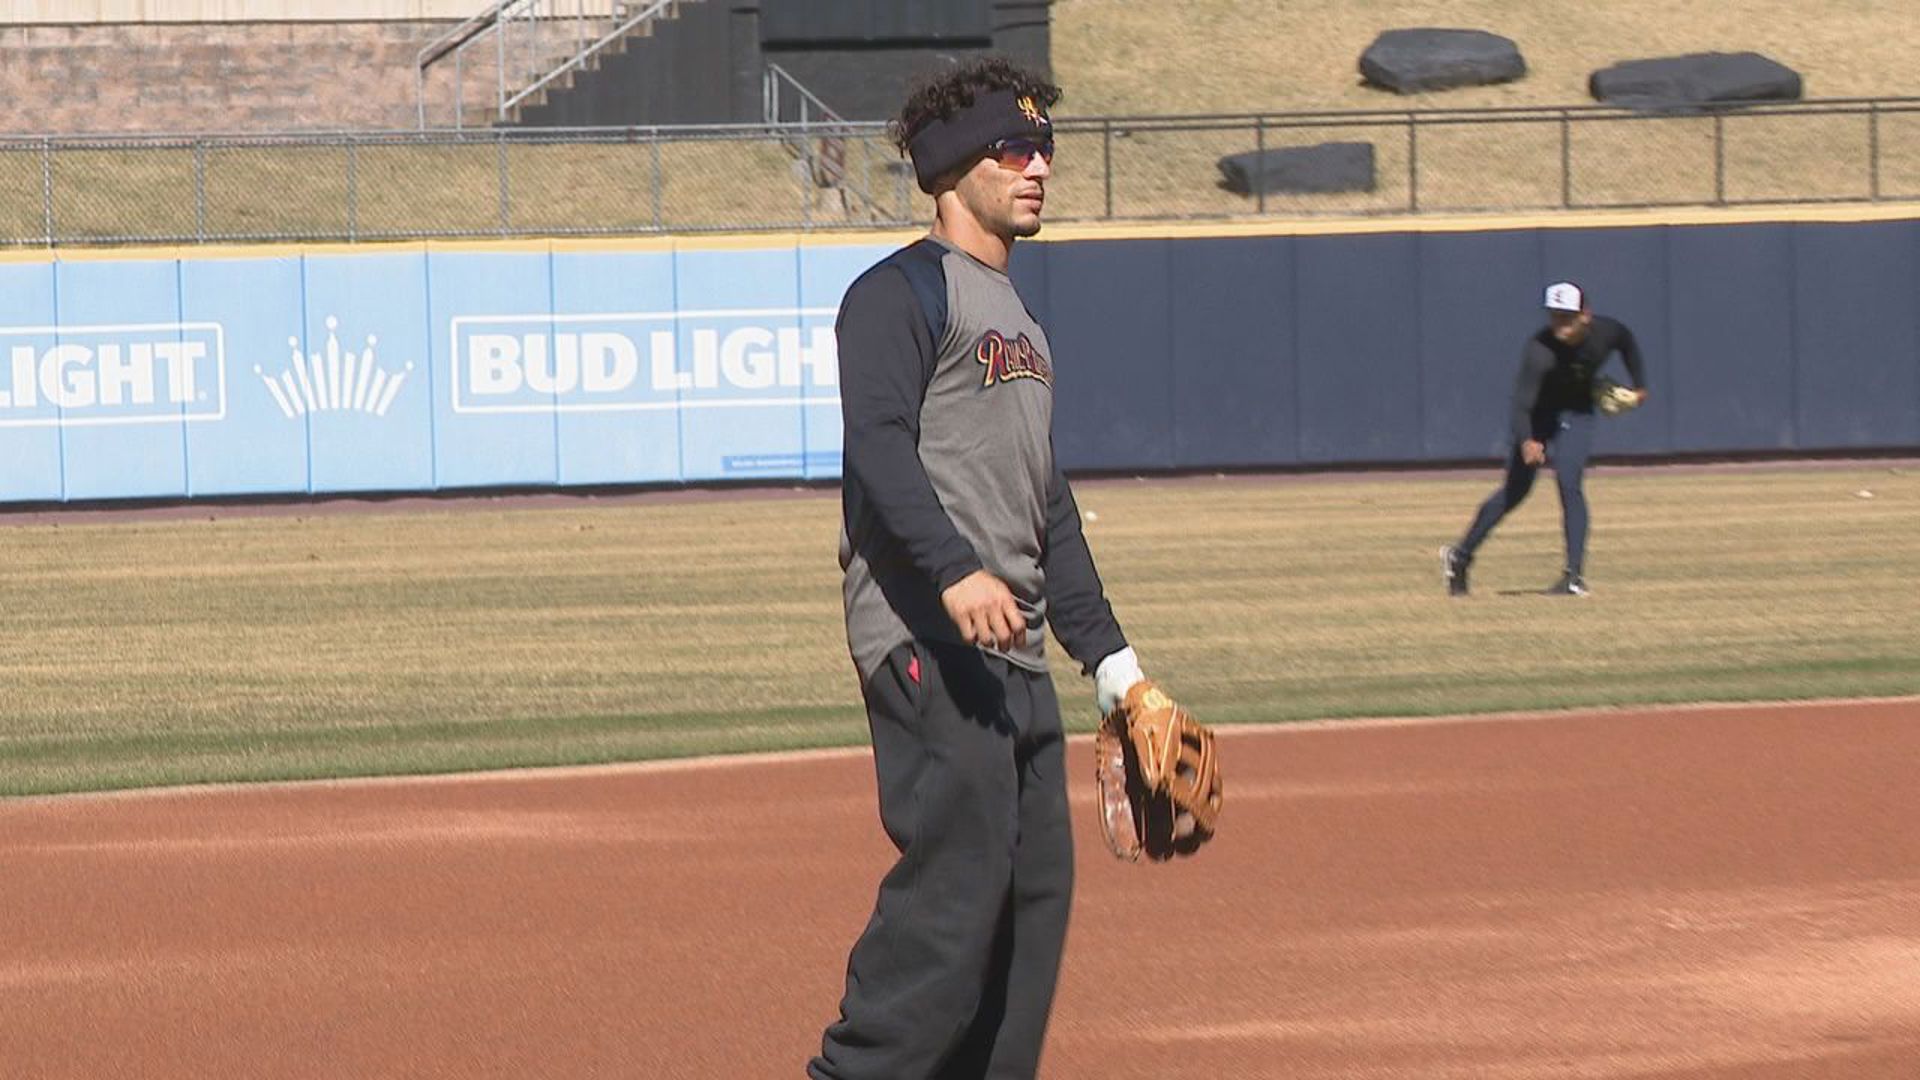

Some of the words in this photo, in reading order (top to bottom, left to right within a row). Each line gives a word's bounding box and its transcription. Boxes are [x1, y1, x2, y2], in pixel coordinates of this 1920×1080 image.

[0, 341, 206, 409] IGHT
[468, 333, 639, 395] BUD
[650, 326, 840, 391] LIGH
